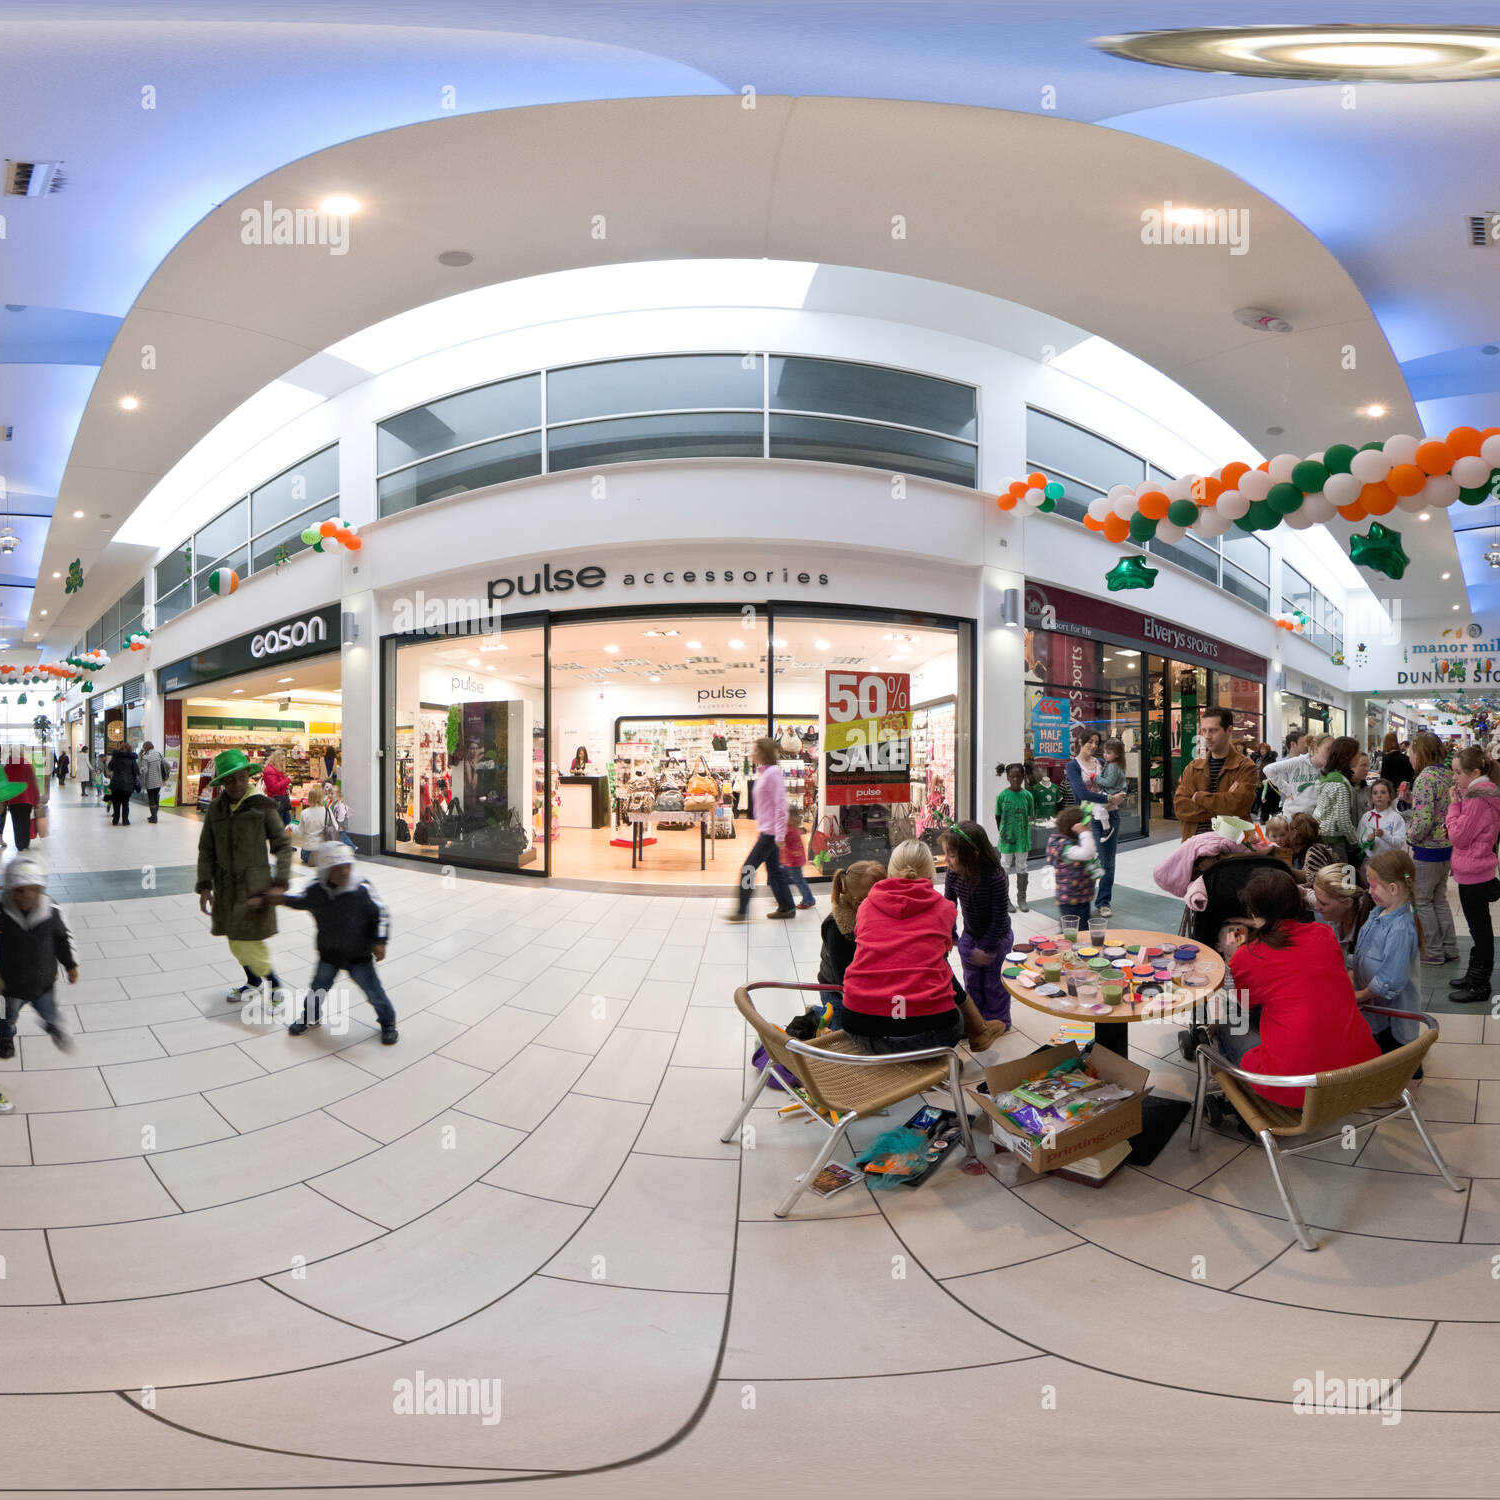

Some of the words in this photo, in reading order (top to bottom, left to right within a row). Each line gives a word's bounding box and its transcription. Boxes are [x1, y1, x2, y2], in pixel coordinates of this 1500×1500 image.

[487, 563, 607, 608] pulse
[622, 568, 830, 586] accessories
[250, 616, 327, 659] eason
[1143, 617, 1186, 648] Elverys
[1187, 635, 1218, 657] SPORTS
[1412, 643, 1468, 653] manor
[451, 676, 485, 694] pulse
[697, 685, 747, 703] pulse
[828, 673, 907, 723] 50%
[1040, 729, 1062, 740] HALF
[828, 741, 908, 773] SALE
[1039, 742, 1063, 754] PRICE
[856, 788, 881, 797] pulse
